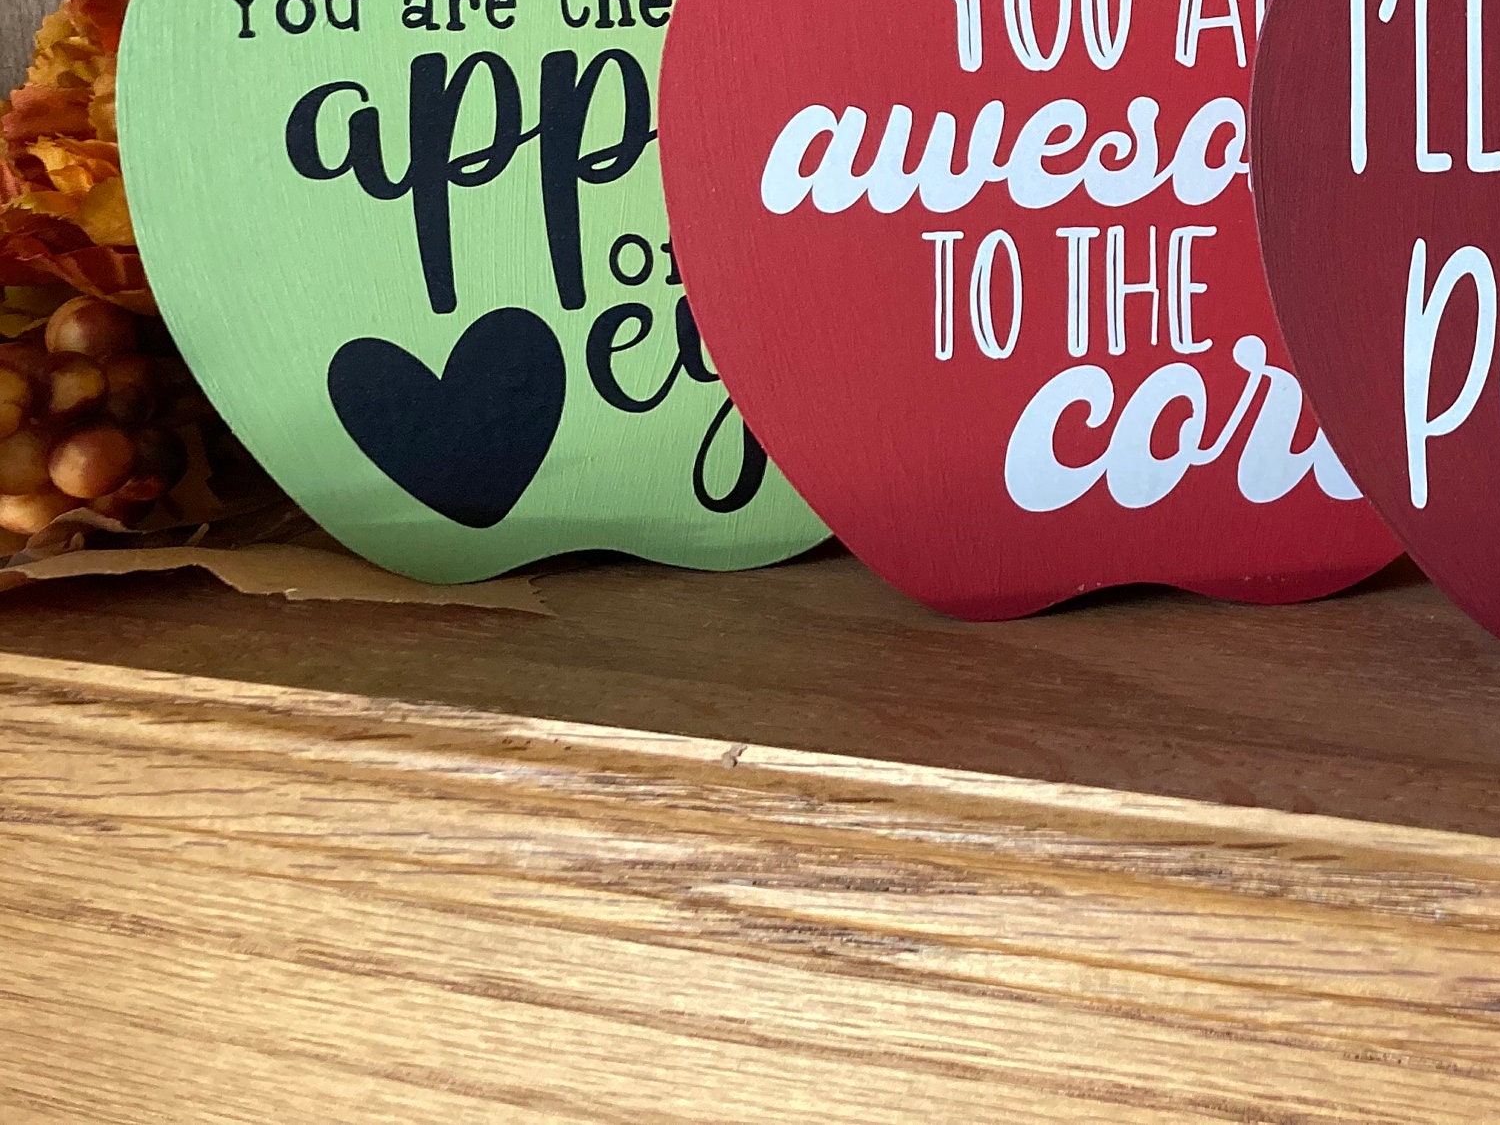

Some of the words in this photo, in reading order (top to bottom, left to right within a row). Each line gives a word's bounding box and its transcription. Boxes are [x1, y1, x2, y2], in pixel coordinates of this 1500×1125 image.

[760, 96, 1255, 215] aweso
[921, 228, 1023, 362] TO
[1055, 224, 1218, 358] THE
